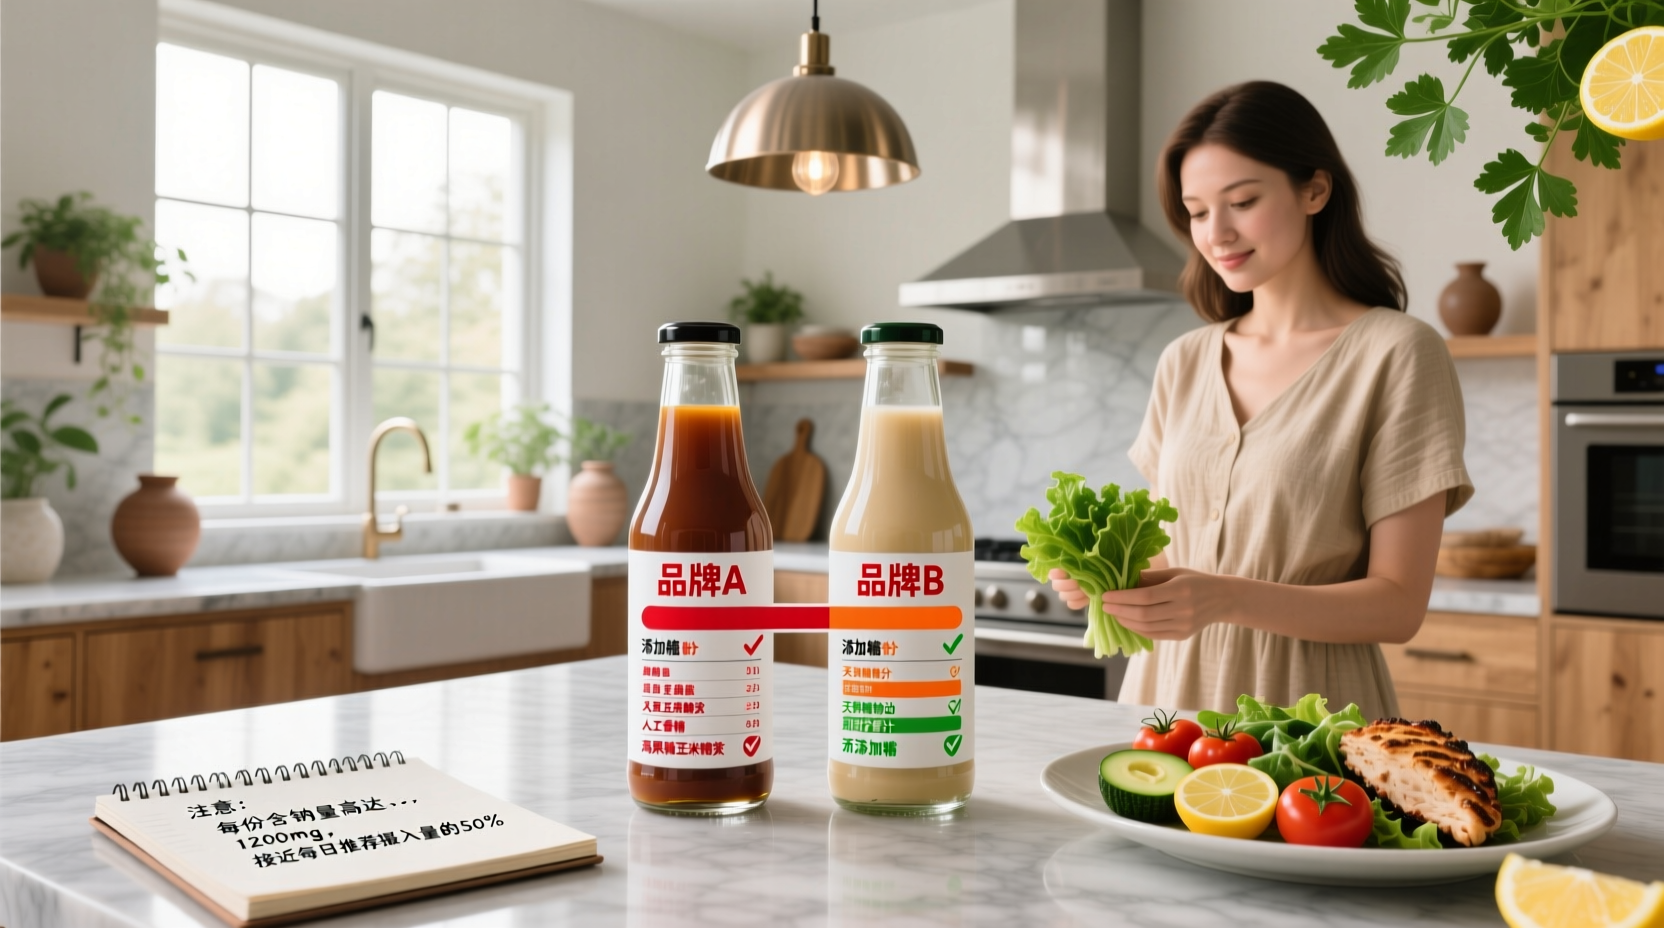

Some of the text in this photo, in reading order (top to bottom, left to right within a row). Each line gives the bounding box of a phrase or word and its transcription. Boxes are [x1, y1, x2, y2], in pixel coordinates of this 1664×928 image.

[658, 563, 747, 597] 品牌A
[857, 563, 945, 597] 品牌B
[187, 799, 247, 819] 注意：
[236, 829, 334, 850] 1200mg,
